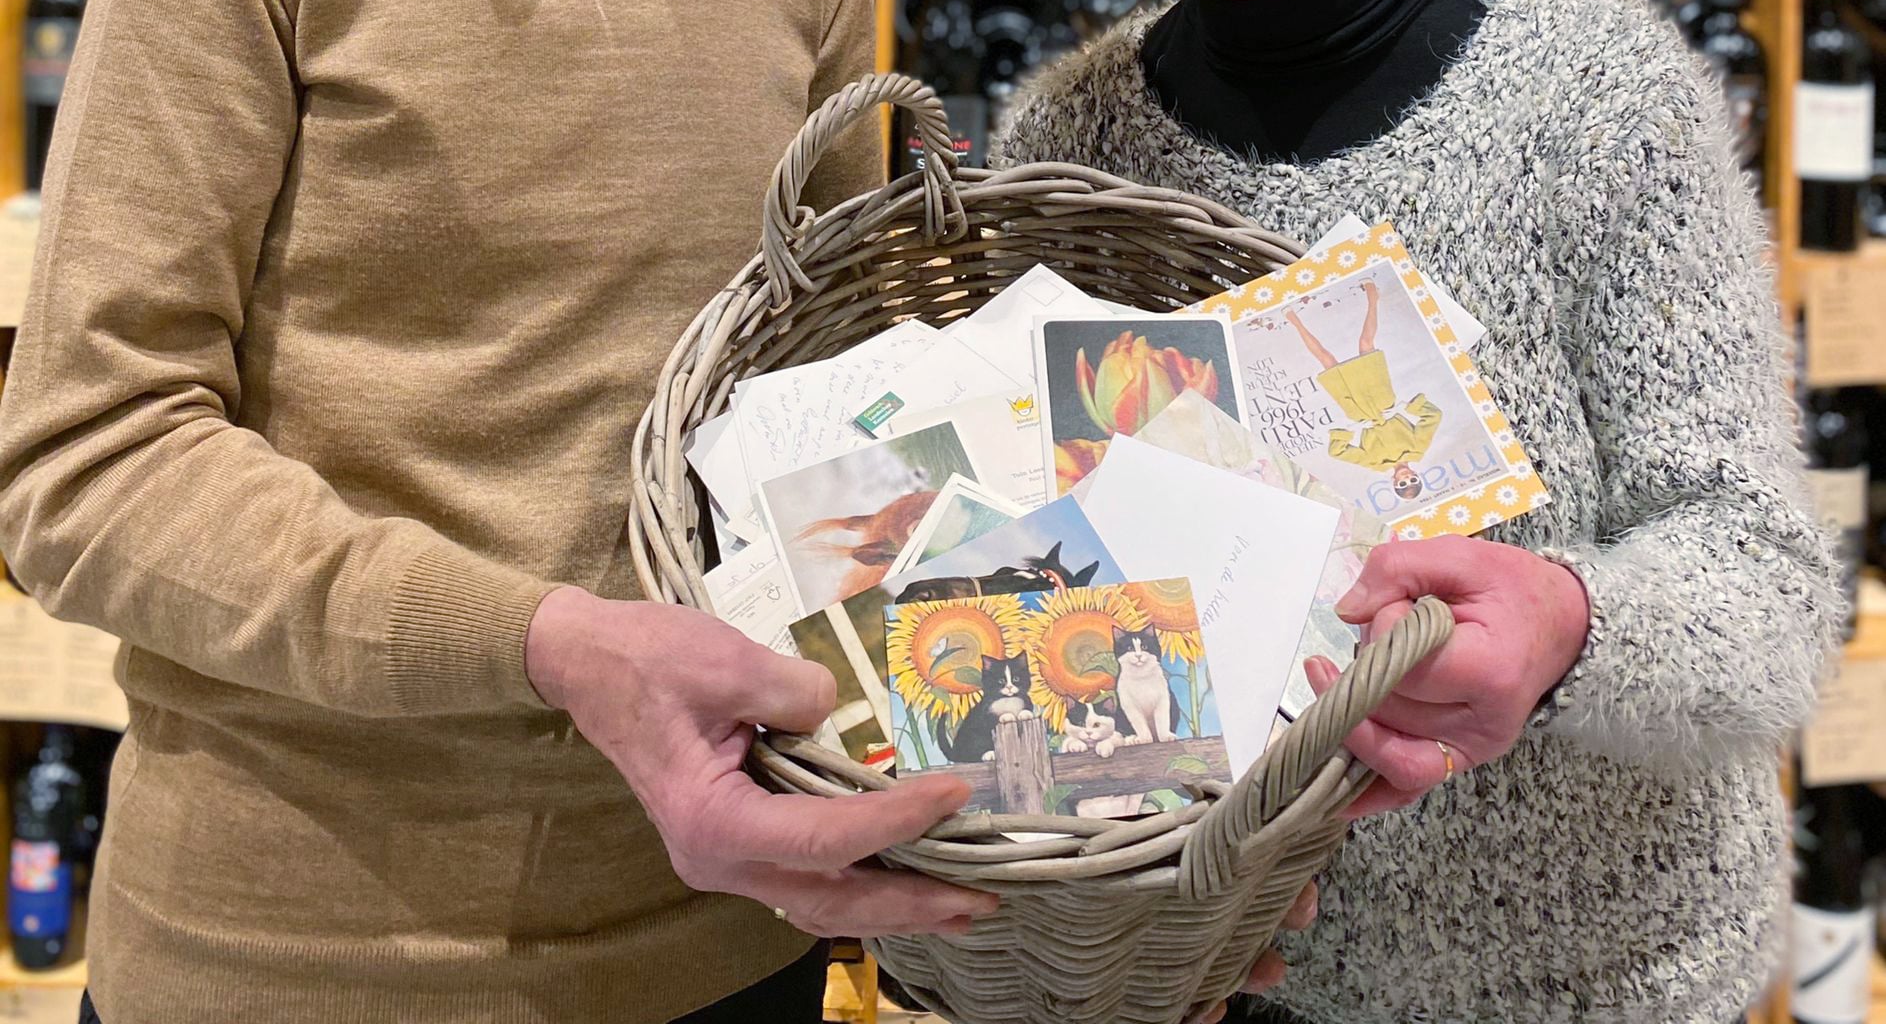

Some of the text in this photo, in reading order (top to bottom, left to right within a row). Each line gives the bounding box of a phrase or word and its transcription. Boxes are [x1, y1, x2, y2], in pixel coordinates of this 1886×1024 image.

[1246, 369, 1287, 391] KLEUR
[1249, 376, 1319, 417] LENT
[1260, 399, 1306, 428] 1966
[1260, 407, 1334, 444] PARIJ
